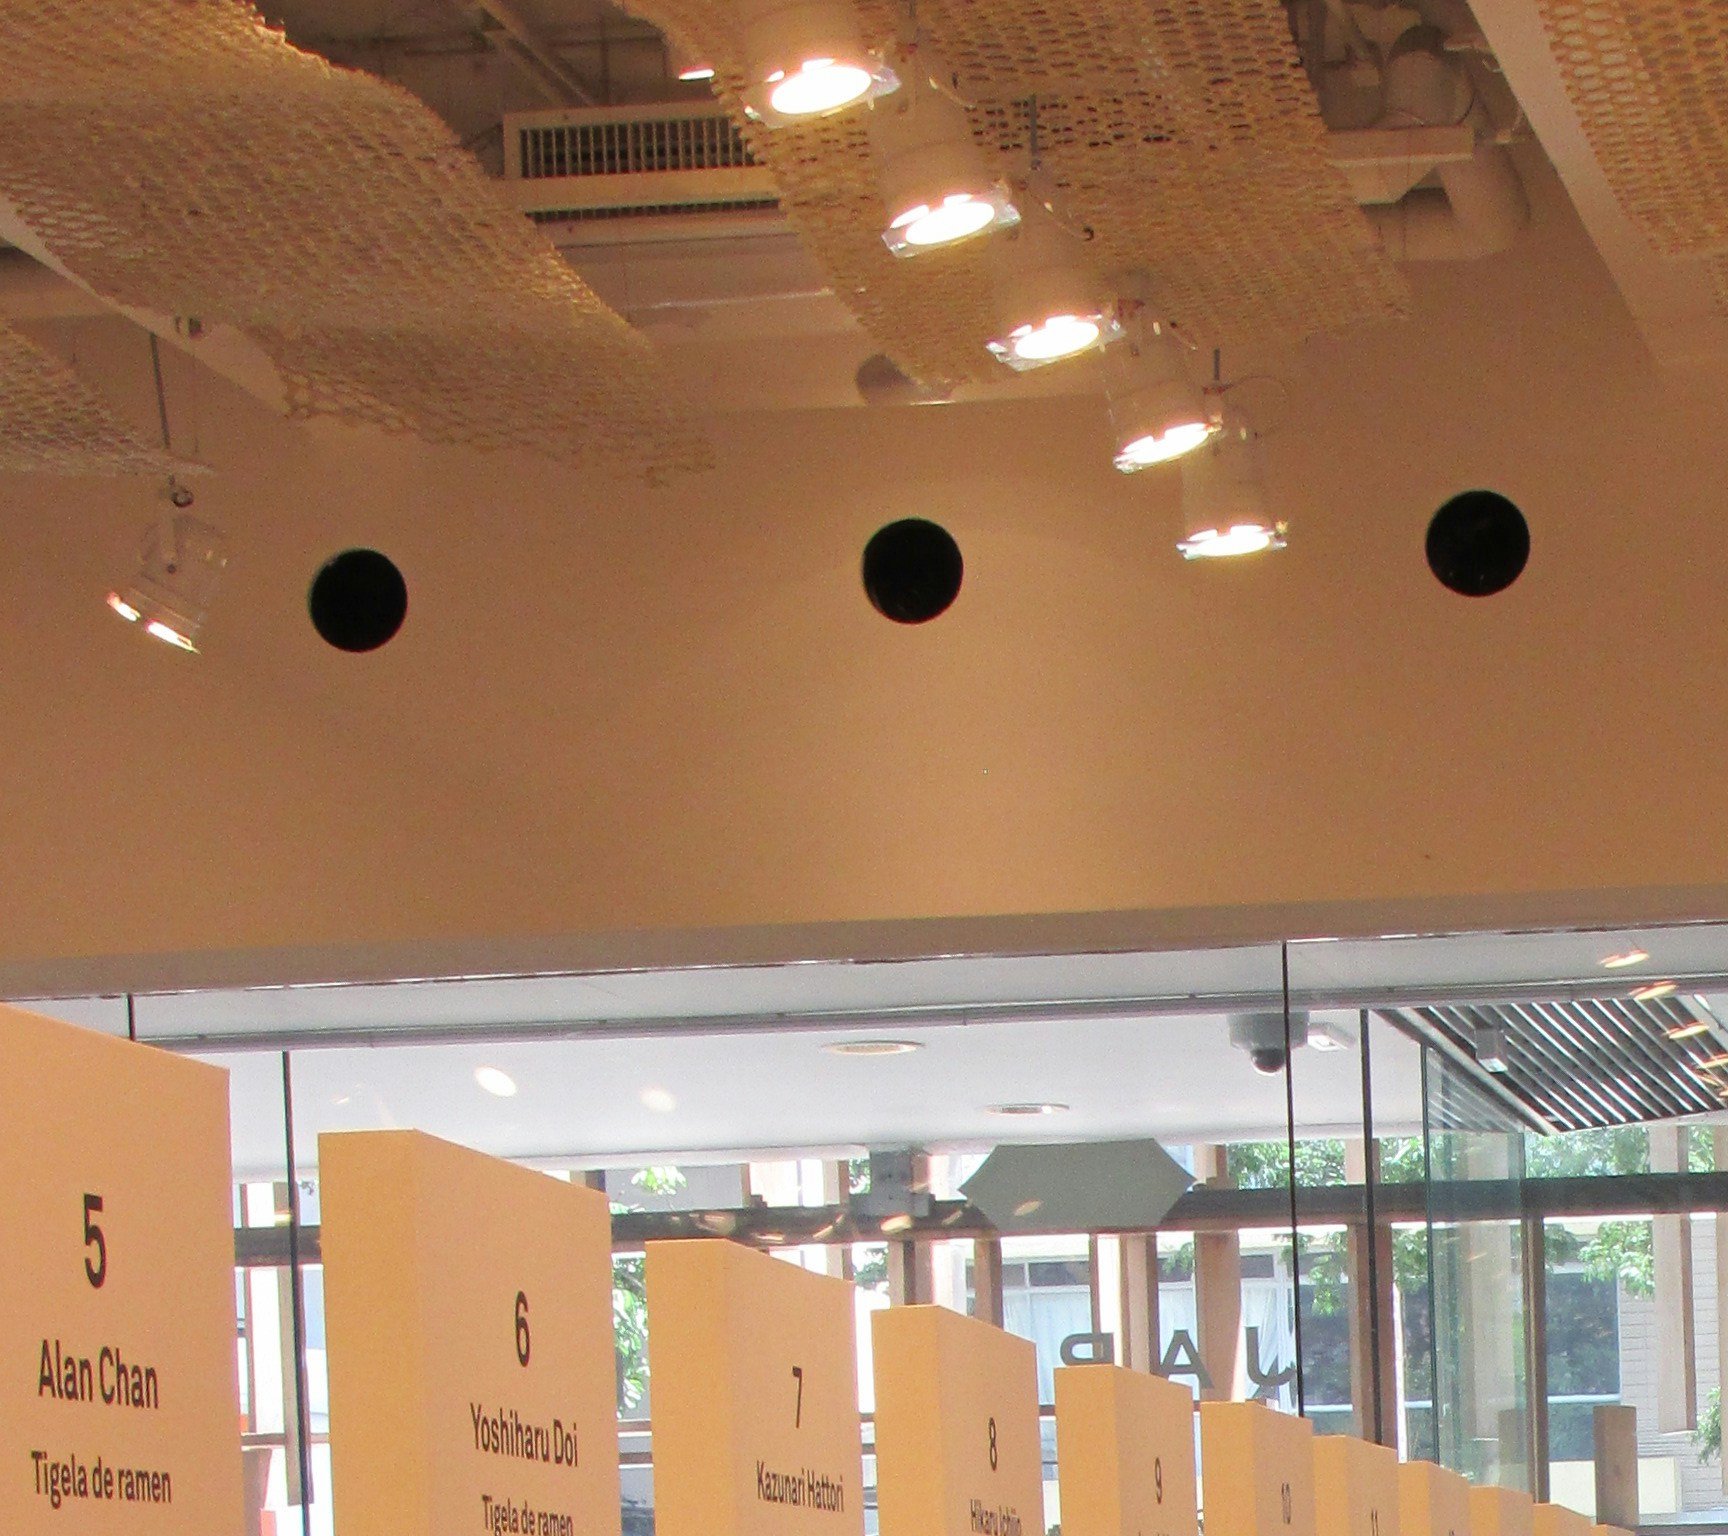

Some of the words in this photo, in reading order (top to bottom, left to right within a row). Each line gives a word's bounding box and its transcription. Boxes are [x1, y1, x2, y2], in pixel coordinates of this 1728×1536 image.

[83, 1193, 107, 1288] 5
[515, 1291, 530, 1367] 6
[38, 1339, 93, 1402] Alan
[99, 1346, 159, 1409] Chan
[792, 1366, 802, 1429] 7
[470, 1402, 550, 1463] Yoshiharu
[553, 1418, 578, 1468] Doi
[989, 1417, 998, 1471] 8
[31, 1450, 88, 1509] Tigela
[92, 1456, 114, 1499] de
[118, 1467, 172, 1503] ramen
[757, 1460, 806, 1506] Kazunari
[807, 1469, 845, 1513] Hattori
[1155, 1457, 1162, 1504] 9
[521, 1500, 536, 1536] de
